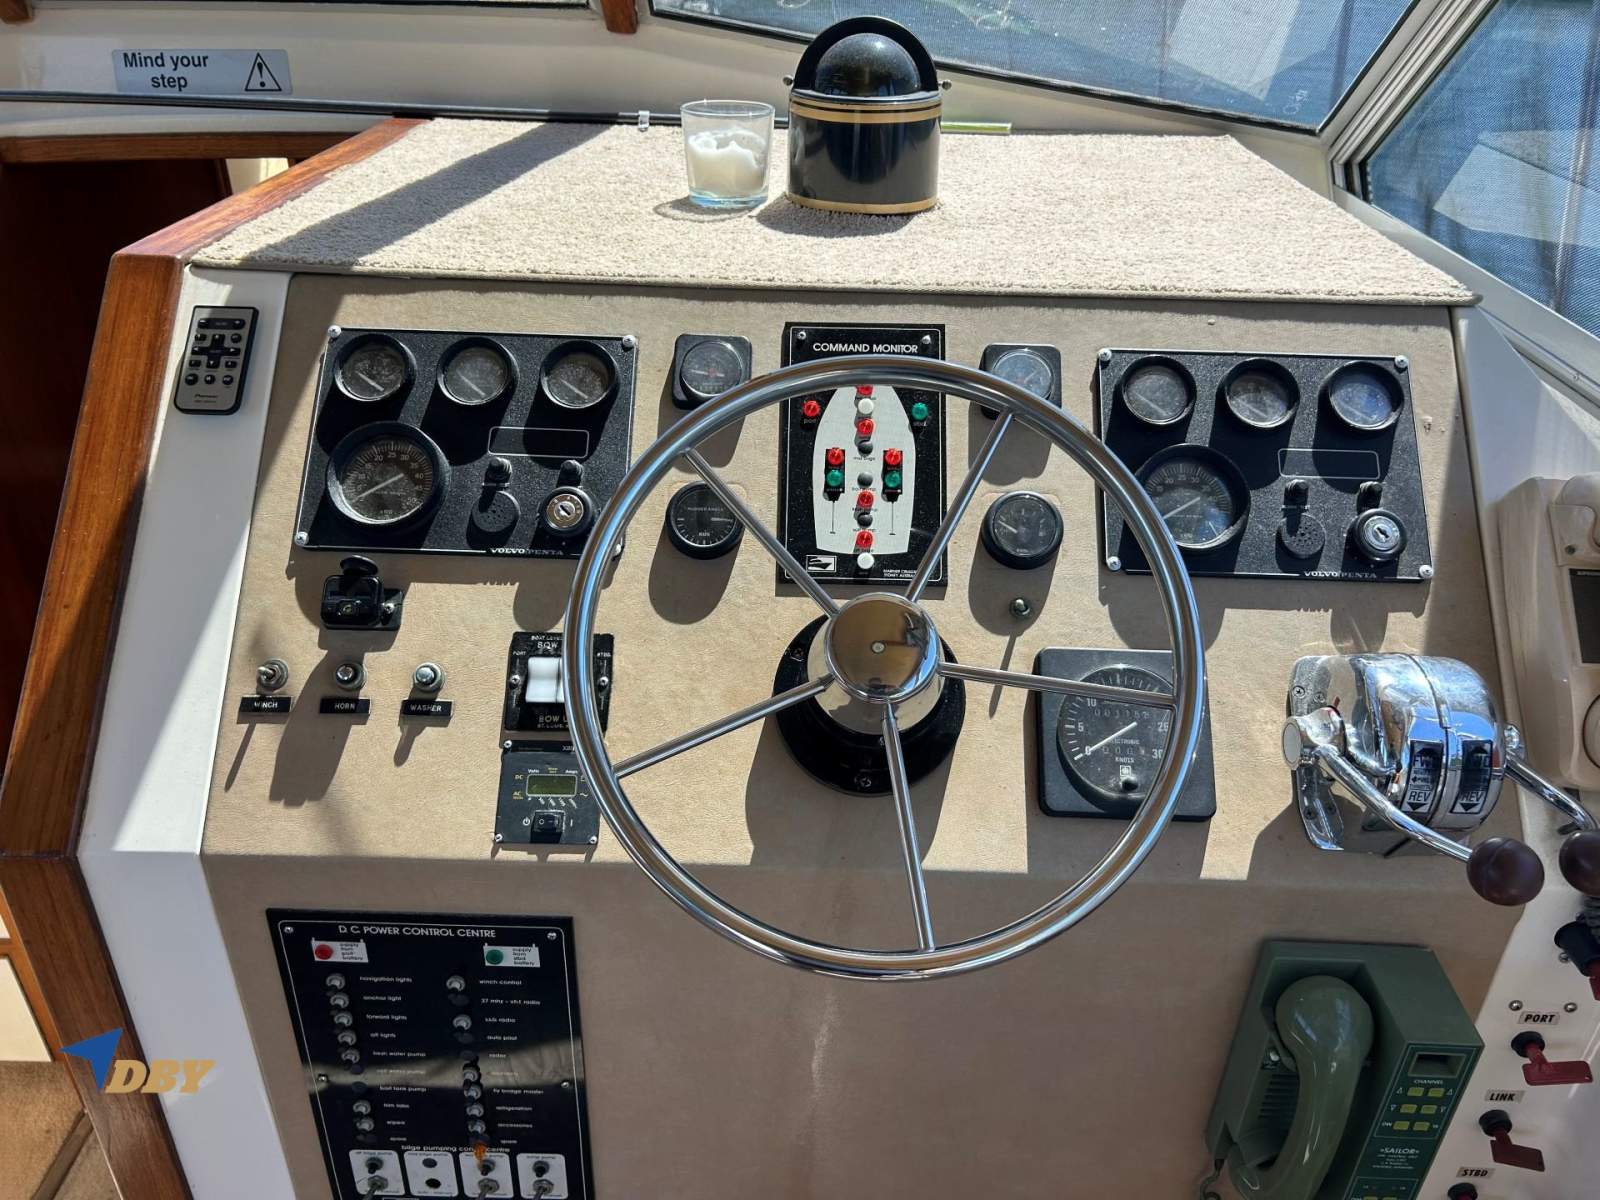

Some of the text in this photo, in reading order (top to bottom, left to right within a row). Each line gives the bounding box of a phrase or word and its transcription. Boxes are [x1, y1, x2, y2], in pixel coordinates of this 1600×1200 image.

[123, 52, 209, 71] Mind your
[151, 74, 188, 92] step
[813, 342, 919, 354] COMMAND MONITOR
[490, 547, 564, 556] VOLVO PENTA
[1303, 570, 1378, 579] VOLVO PENTA
[537, 641, 559, 650] BOW
[253, 701, 278, 709] WINCH
[334, 702, 356, 710] HORN
[1086, 698, 1097, 707] 10
[410, 703, 442, 712] WASHER
[538, 714, 560, 723] BOW
[1077, 721, 1085, 733] 5
[1408, 790, 1431, 802] REV
[1460, 791, 1484, 802] REV
[363, 926, 400, 935] POWER
[402, 927, 455, 937] CONTROL
[457, 928, 497, 938] CENTRE
[1524, 1013, 1556, 1023] PORT
[1489, 1092, 1516, 1101] LINK
[1461, 1168, 1489, 1177] STBD
